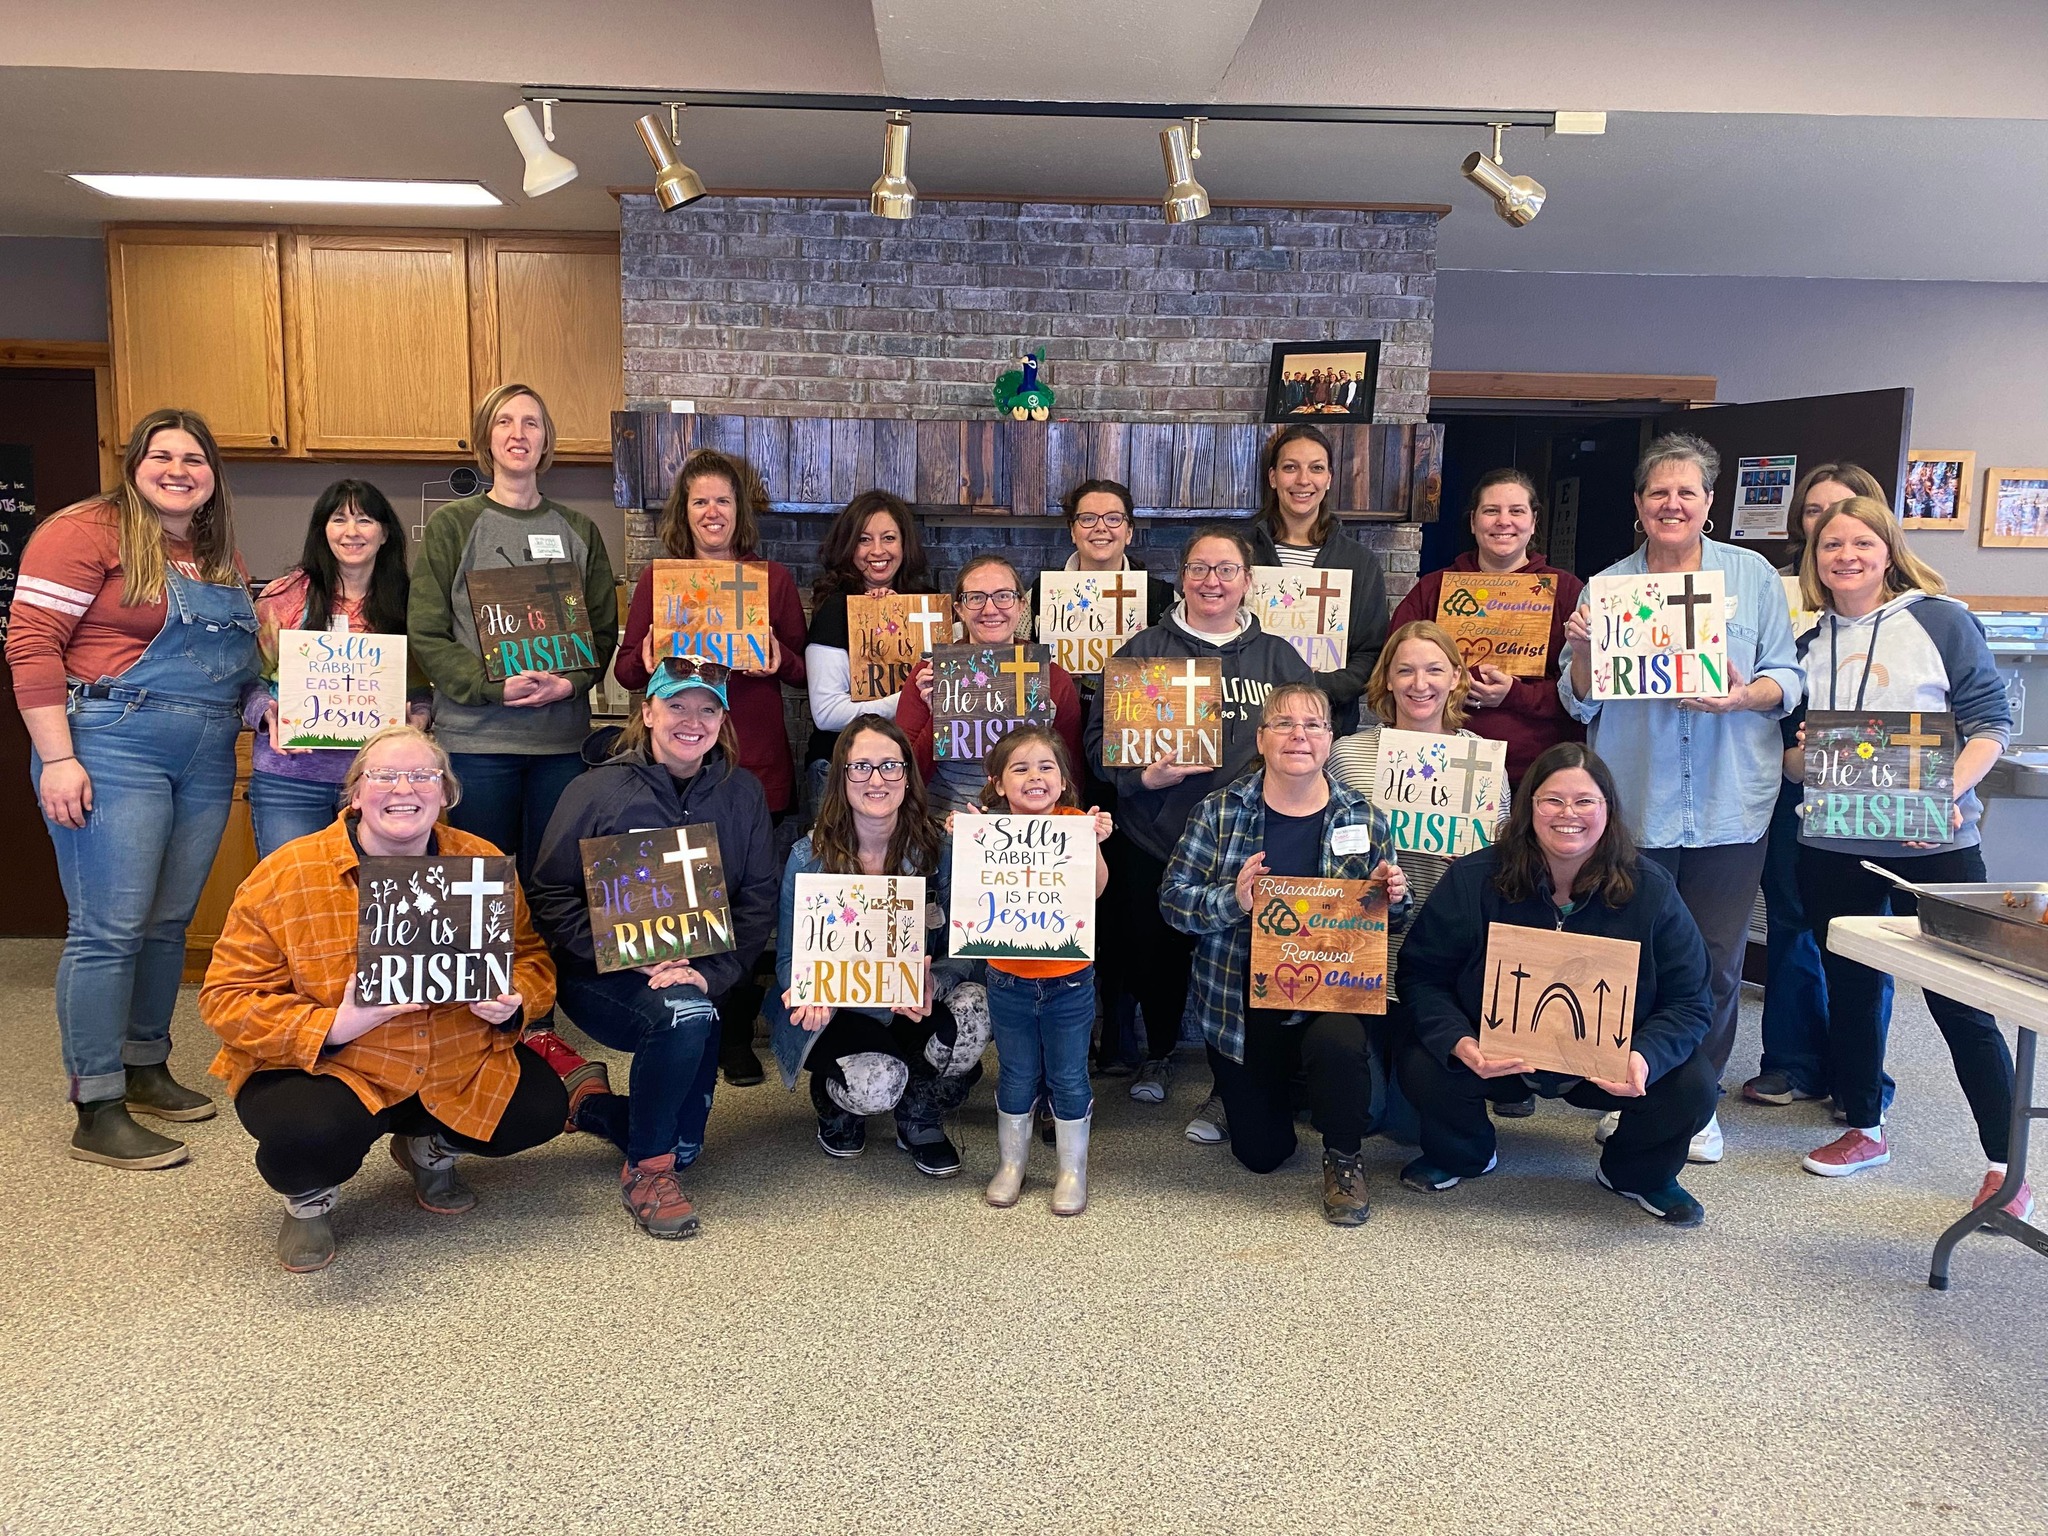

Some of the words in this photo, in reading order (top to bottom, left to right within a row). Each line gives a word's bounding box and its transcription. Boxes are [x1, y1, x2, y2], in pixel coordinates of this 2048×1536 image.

[1444, 573, 1521, 588] Relaxation
[480, 604, 521, 636] He
[526, 605, 546, 631] is
[660, 594, 694, 627] He
[707, 600, 726, 627] is
[1047, 604, 1082, 632] He
[1089, 608, 1107, 632] is
[1291, 605, 1307, 630] is
[1485, 599, 1551, 613] Creation
[856, 628, 890, 658] He
[898, 632, 916, 657] is
[1456, 621, 1525, 637] Renewal
[1601, 615, 1643, 651] He
[1652, 618, 1673, 648] is
[312, 634, 386, 667] Silly
[500, 631, 596, 677] RISEN
[672, 631, 766, 670] RISEN
[1495, 641, 1545, 657] Christ
[309, 661, 368, 675] RABBIT
[867, 662, 912, 697] RIS
[1612, 652, 1724, 697] RISEN
[303, 695, 385, 729] Jesus
[328, 695, 342, 705] IS
[348, 695, 378, 706] FOR
[937, 679, 978, 713] He
[986, 683, 1007, 713] is
[1110, 690, 1148, 722] He
[1156, 698, 1176, 722] is
[1120, 728, 1219, 765] RISEN
[1813, 749, 1861, 786] He
[1871, 756, 1898, 787] is
[1382, 767, 1422, 803] He
[1431, 777, 1453, 807] is
[1390, 808, 1497, 856] RISEN
[1825, 793, 1951, 840] RISEN
[988, 817, 1072, 856] Silly
[984, 850, 1050, 866] RABBIT
[594, 878, 642, 917] He
[651, 878, 675, 909] is
[1005, 890, 1021, 904] IS
[1027, 891, 1062, 904] FOR
[1258, 878, 1345, 898] Relaxation
[976, 891, 1071, 933] Jesus
[1308, 913, 1385, 932] Creation
[1322, 902, 1331, 910] in
[365, 903, 420, 946] He
[430, 908, 458, 946] is
[613, 906, 731, 966] RISEN
[802, 914, 845, 952] He
[854, 921, 876, 953] is
[1279, 942, 1355, 964] Renewal
[378, 952, 514, 1005] RISEN
[812, 959, 922, 1005] RISEN
[1304, 975, 1314, 983] in
[1324, 970, 1383, 990] Christ
